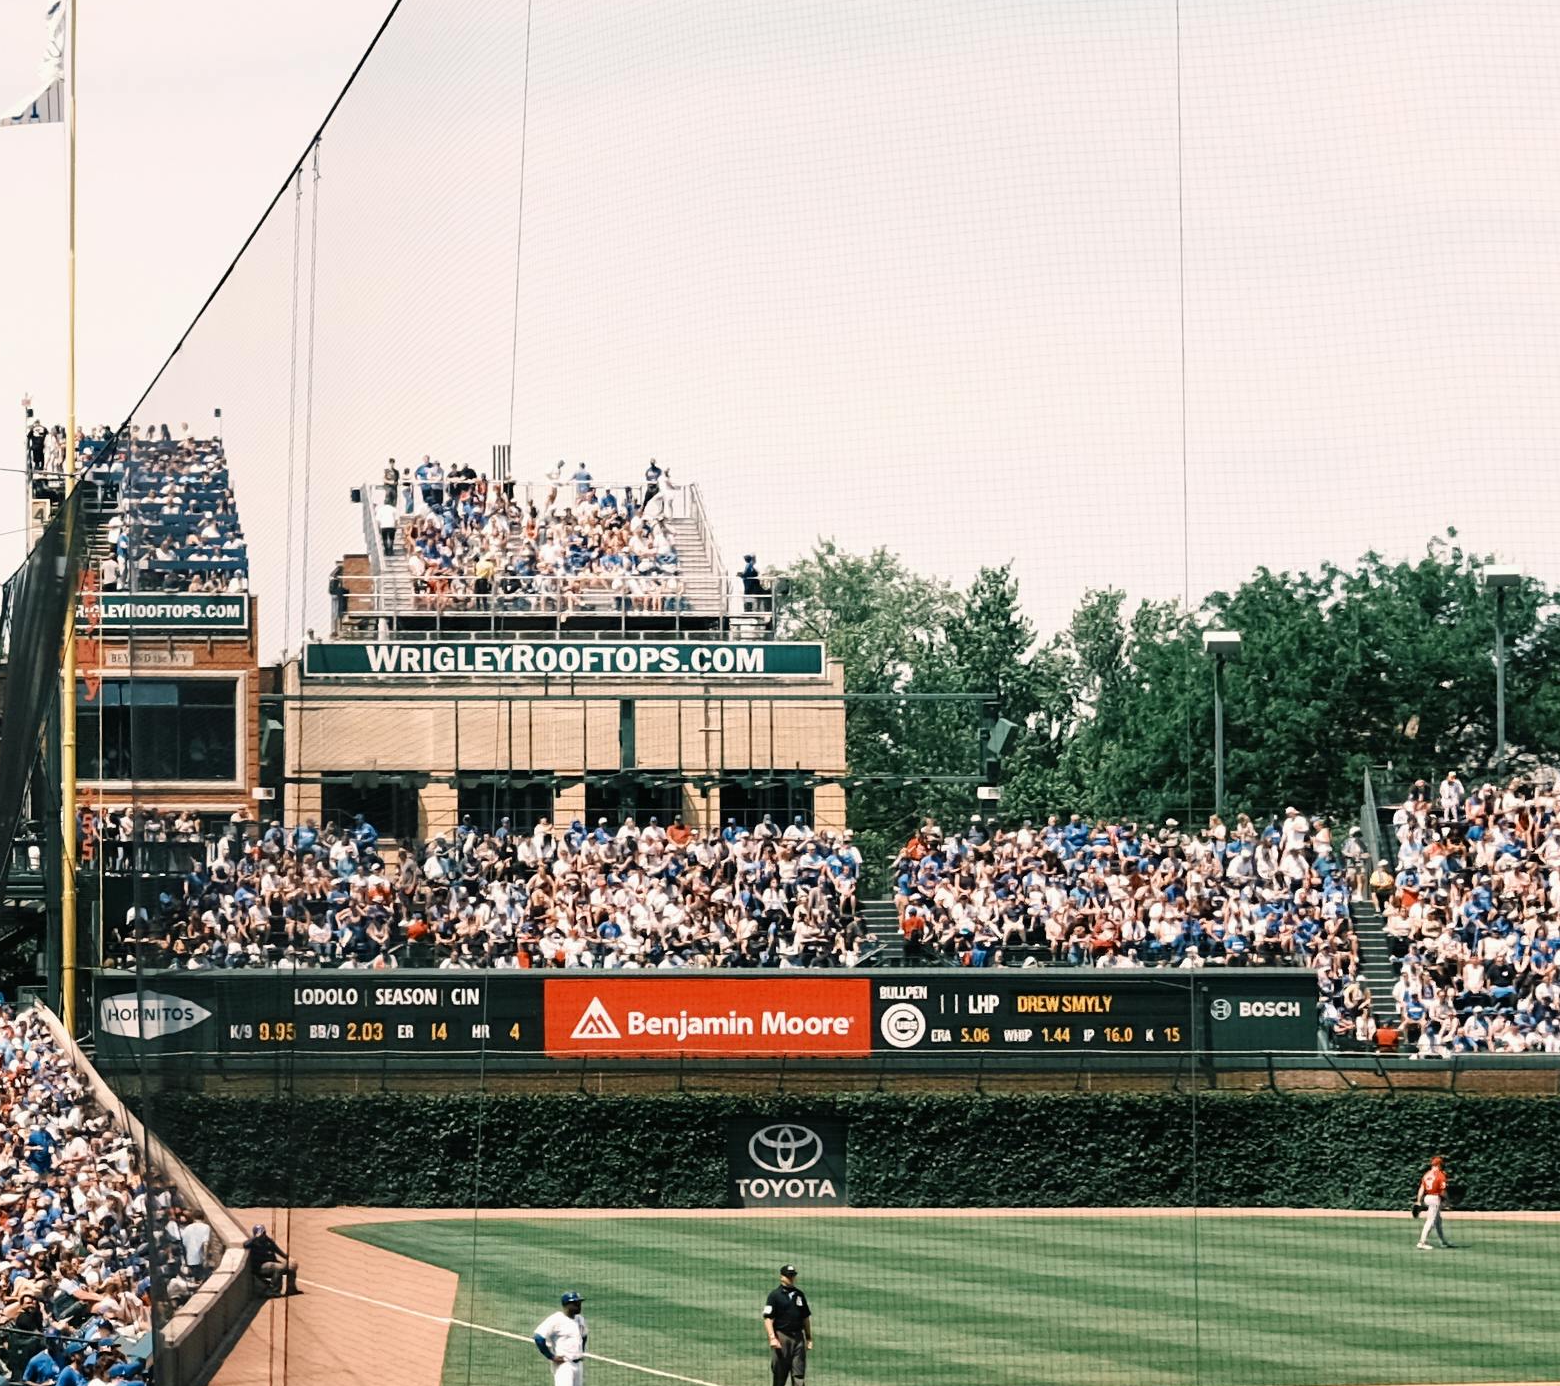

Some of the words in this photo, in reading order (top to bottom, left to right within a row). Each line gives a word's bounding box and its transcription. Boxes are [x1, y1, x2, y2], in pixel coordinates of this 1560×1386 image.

[294, 988, 358, 1005] LODOLO
[376, 988, 437, 1005] SEASON
[451, 988, 479, 1005] CIN
[879, 985, 928, 1000] BULLPEN
[968, 995, 1000, 1014] LHP
[1018, 995, 1059, 1014] DREW
[1062, 995, 1112, 1014] SMYLY
[1239, 1001, 1300, 1017] BOSCH
[230, 1024, 253, 1040] K/9
[310, 1024, 340, 1040] BB/9
[346, 1023, 383, 1042] 2.03
[398, 1024, 414, 1040] ER
[431, 1023, 448, 1041] 14
[472, 1024, 490, 1040] HR
[509, 1023, 520, 1041] 4
[628, 1010, 753, 1042] Benjamin
[762, 1011, 850, 1035] Moore
[931, 1029, 951, 1043] ERA
[960, 1028, 990, 1043] 5.06
[1004, 1029, 1032, 1043] WHIP
[1041, 1028, 1070, 1043] 1.44
[1083, 1029, 1094, 1043] IP
[1104, 1028, 1133, 1043] 16.0
[1146, 1029, 1154, 1043] K
[1164, 1028, 1180, 1043] 15
[736, 1178, 837, 1199] TOYOTA
